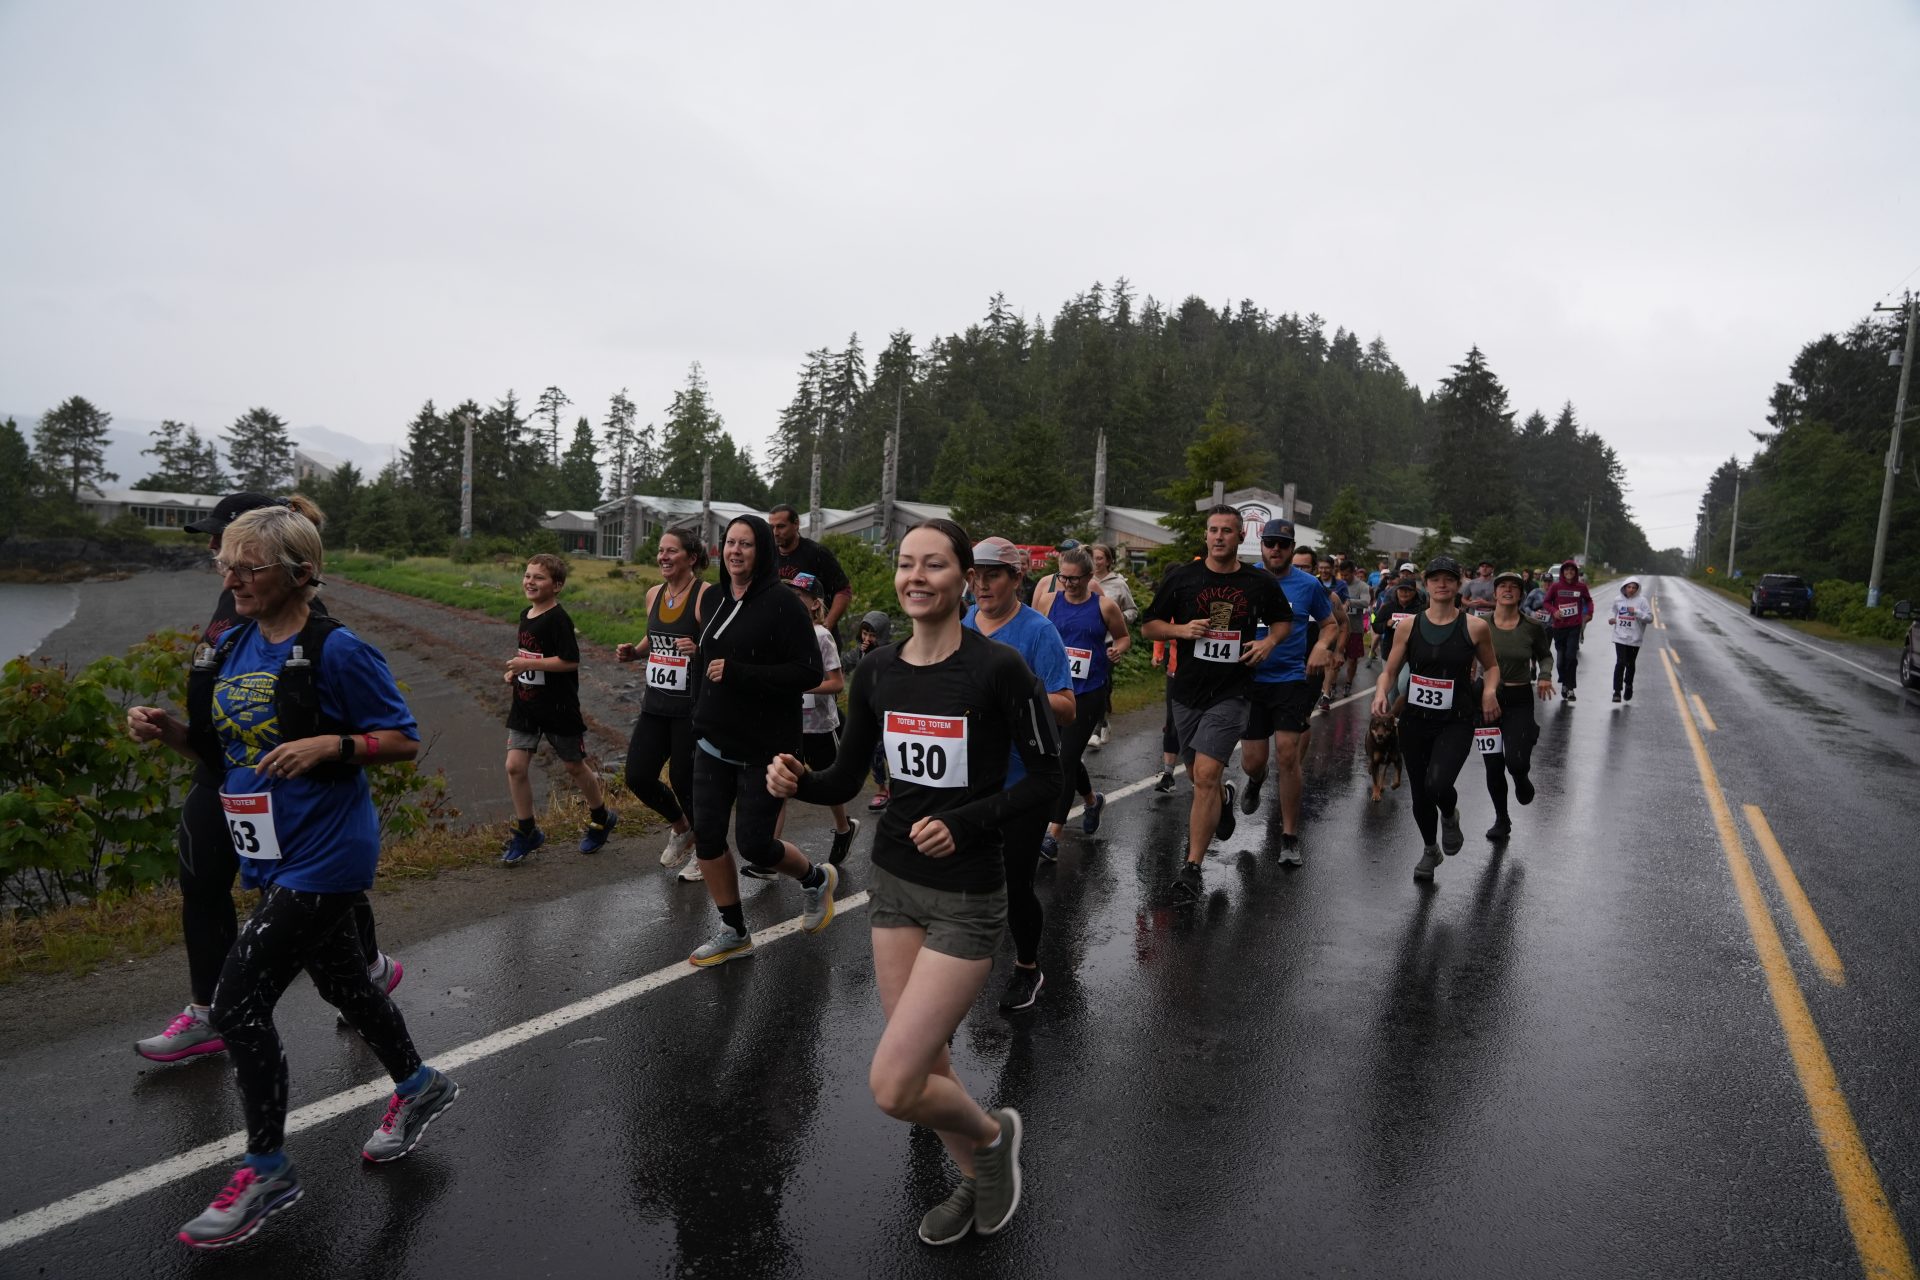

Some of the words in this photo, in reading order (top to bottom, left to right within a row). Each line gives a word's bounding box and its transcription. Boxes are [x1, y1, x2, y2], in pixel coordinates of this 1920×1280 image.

[651, 635, 679, 649] RU
[1203, 641, 1231, 659] 114
[651, 666, 677, 686] 164
[1416, 687, 1443, 706] 233
[897, 717, 915, 726] TOTEM
[917, 719, 926, 727] TO
[928, 720, 951, 729] TOTEM
[898, 741, 947, 781] 130
[231, 798, 256, 806] TOTEM
